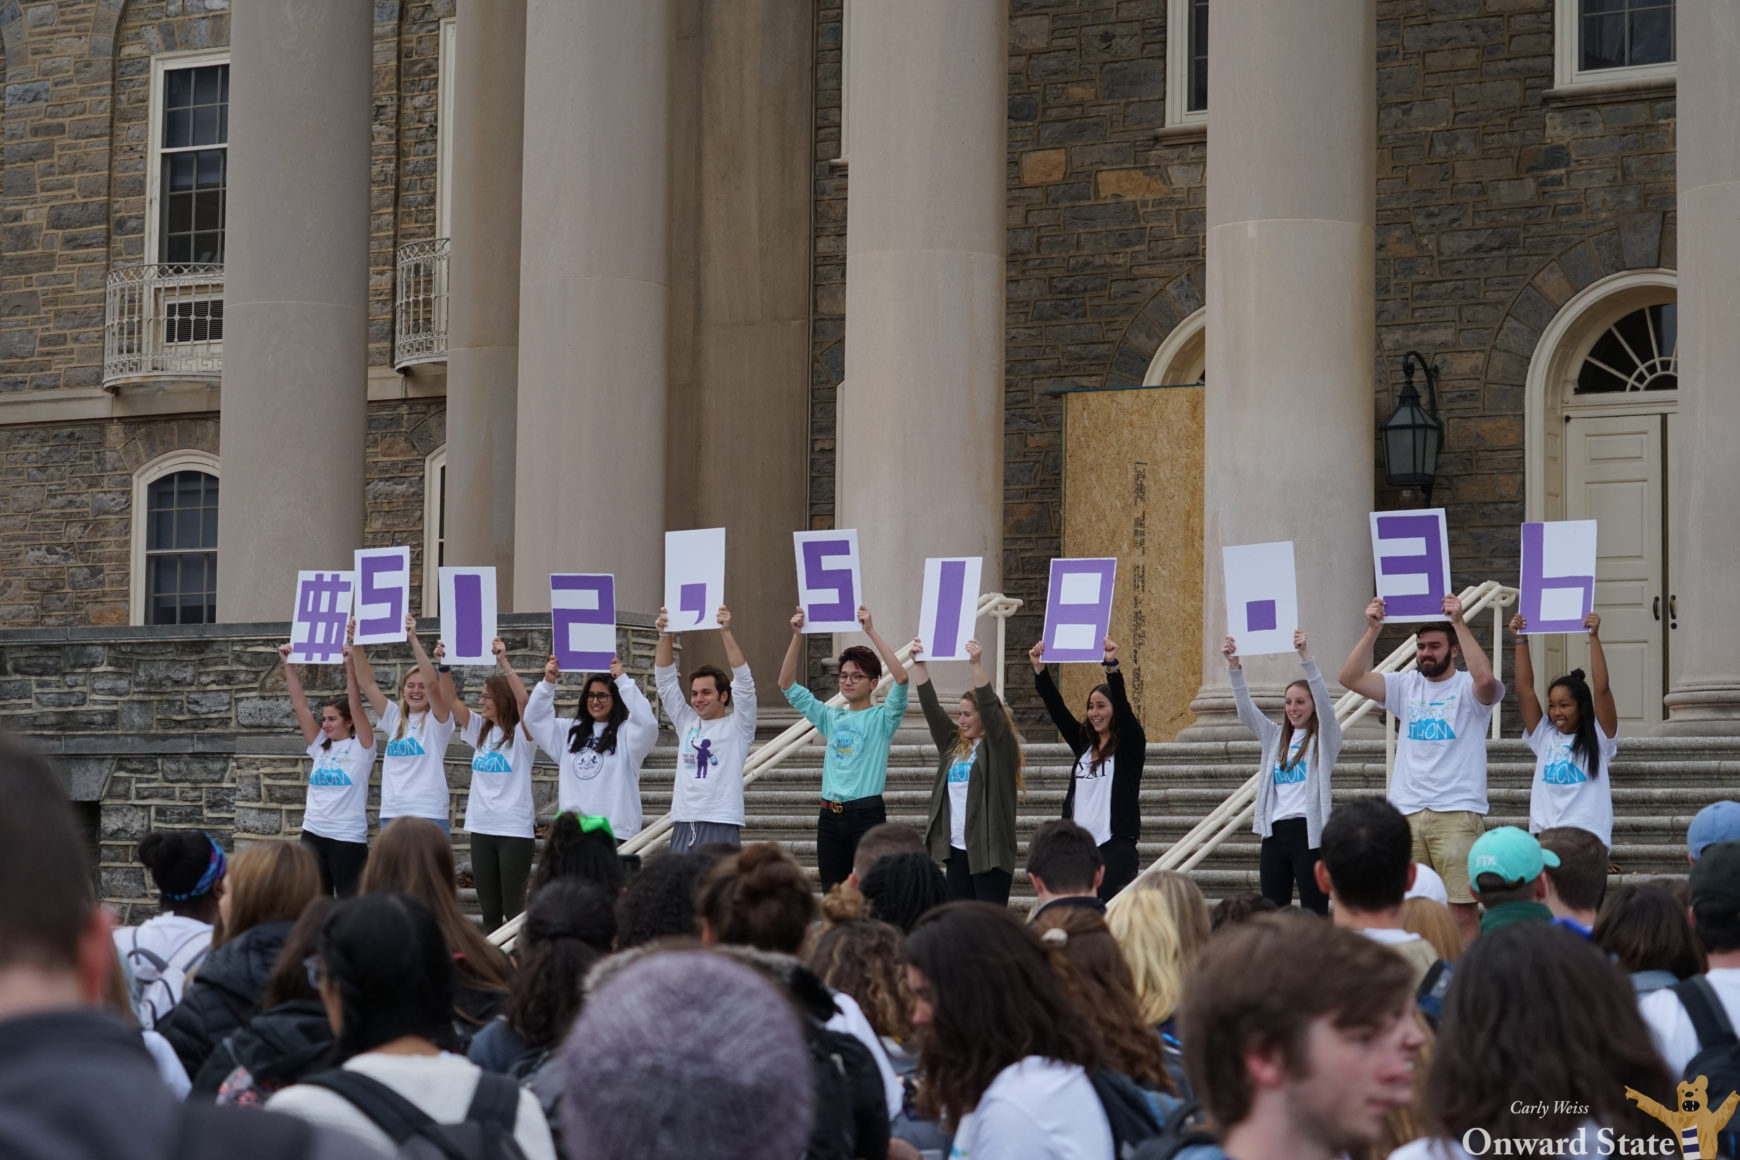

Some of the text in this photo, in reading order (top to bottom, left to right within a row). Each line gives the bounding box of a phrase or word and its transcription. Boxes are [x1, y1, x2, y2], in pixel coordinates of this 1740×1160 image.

[1408, 720, 1448, 740] THON
[1544, 763, 1580, 784] THON
[1475, 855, 1497, 868] FTK
